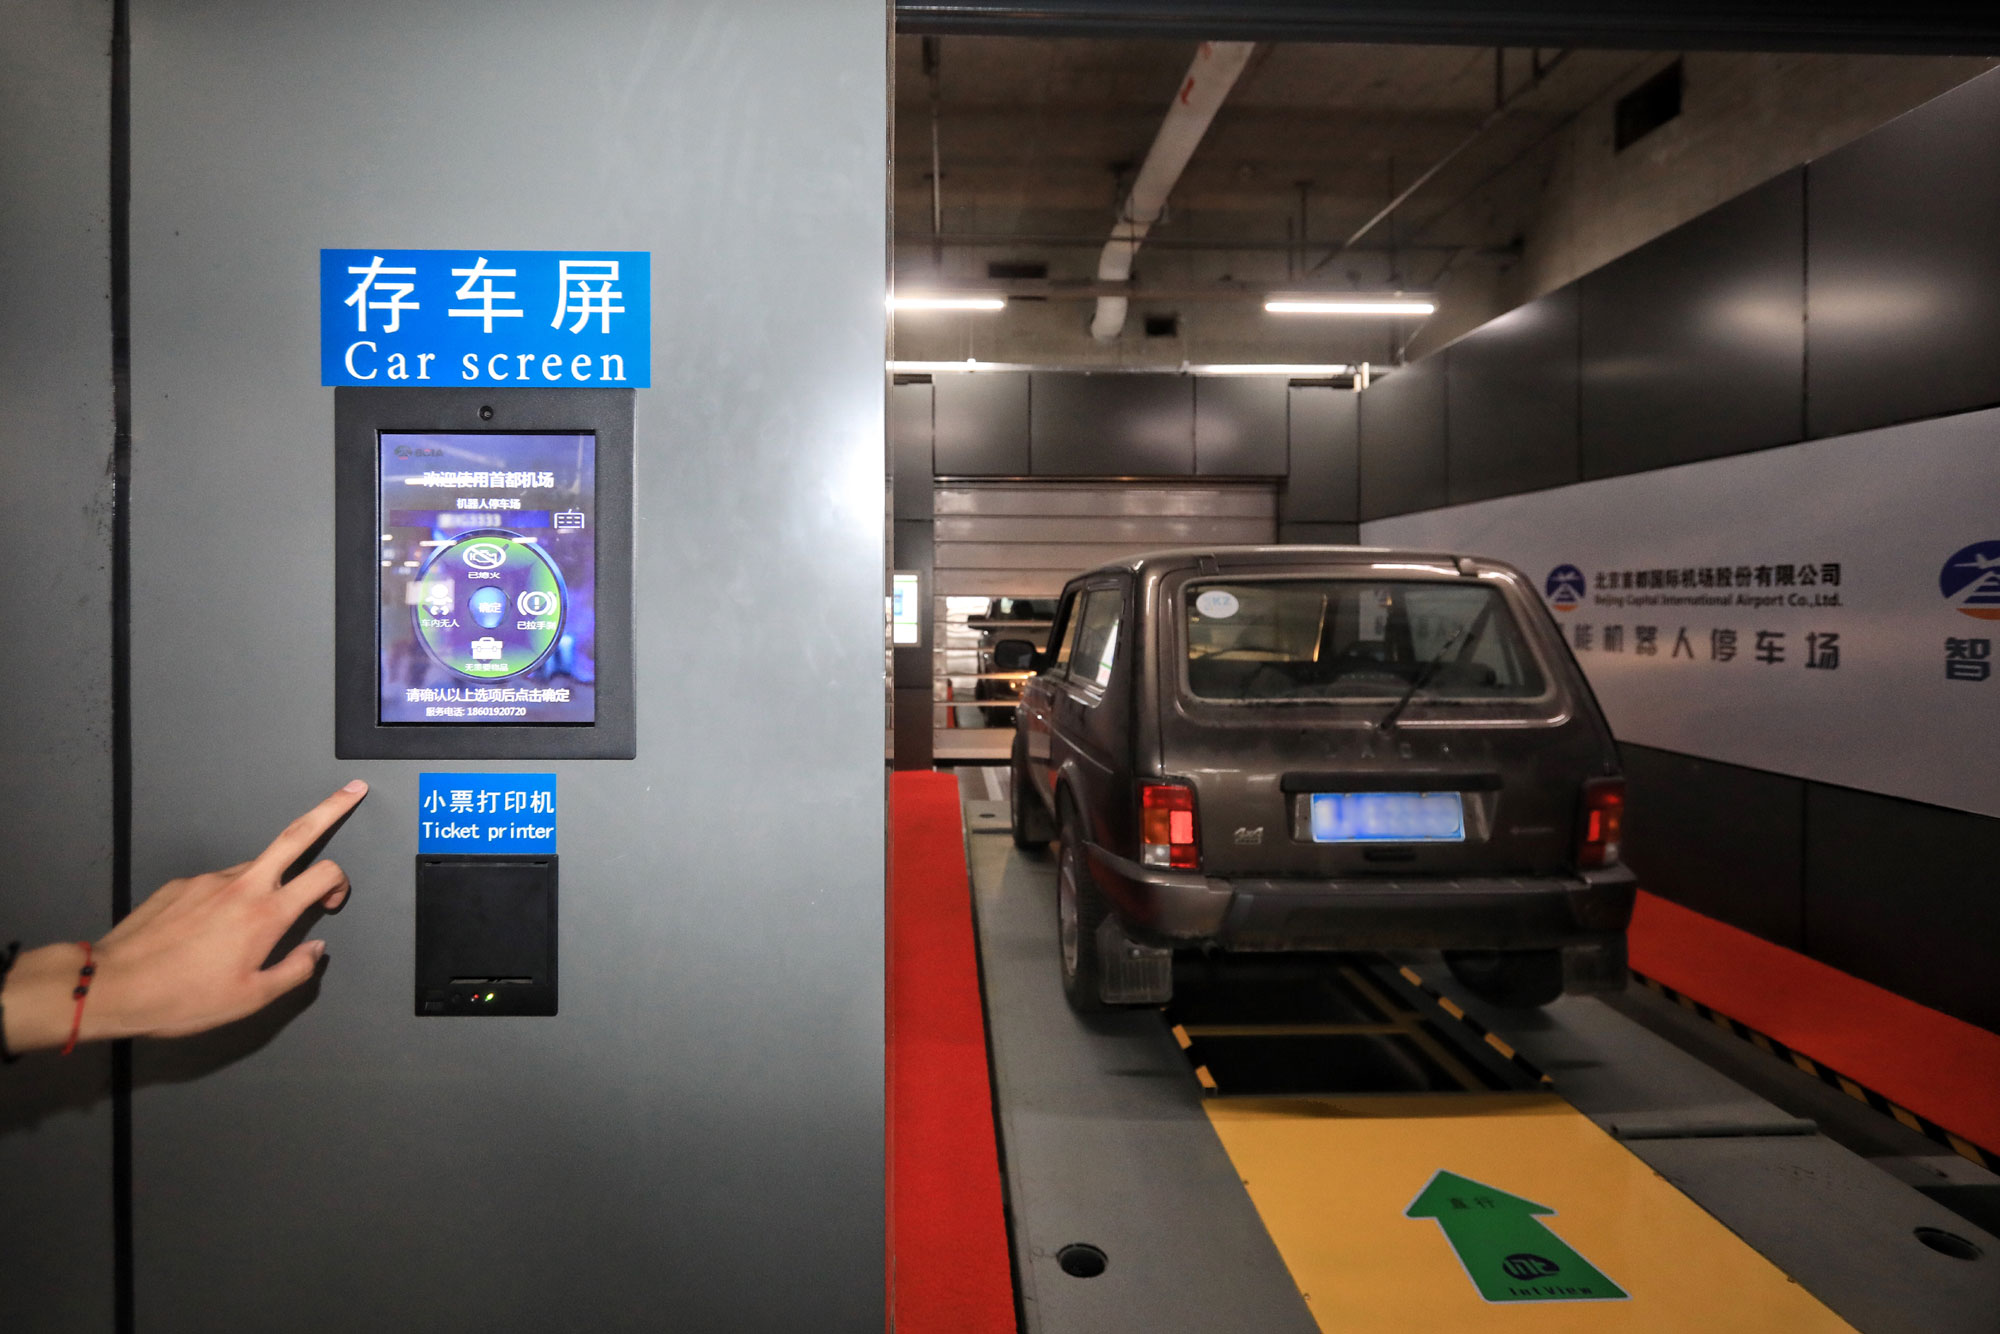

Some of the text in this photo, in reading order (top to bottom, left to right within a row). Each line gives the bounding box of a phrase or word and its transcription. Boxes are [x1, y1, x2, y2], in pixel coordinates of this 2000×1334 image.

[344, 255, 626, 334] 存车屏
[344, 340, 627, 381] Car screen
[423, 471, 554, 488] 欢迎使用首都机场
[456, 498, 521, 509] 机器人停车场
[468, 571, 501, 579] 已熄火
[1595, 563, 1841, 589] 北京首都国际机场股份有限公司
[1661, 593, 1733, 607] International
[1735, 594, 1784, 609] Airport
[1557, 622, 1841, 670] 能机器人停车场
[1944, 636, 1992, 682] 智
[406, 688, 570, 703] 请确认以上选项后点击确定
[467, 706, 527, 716] 18601920720
[423, 789, 555, 814] 小票打印机
[422, 821, 554, 842] Ticket printer
